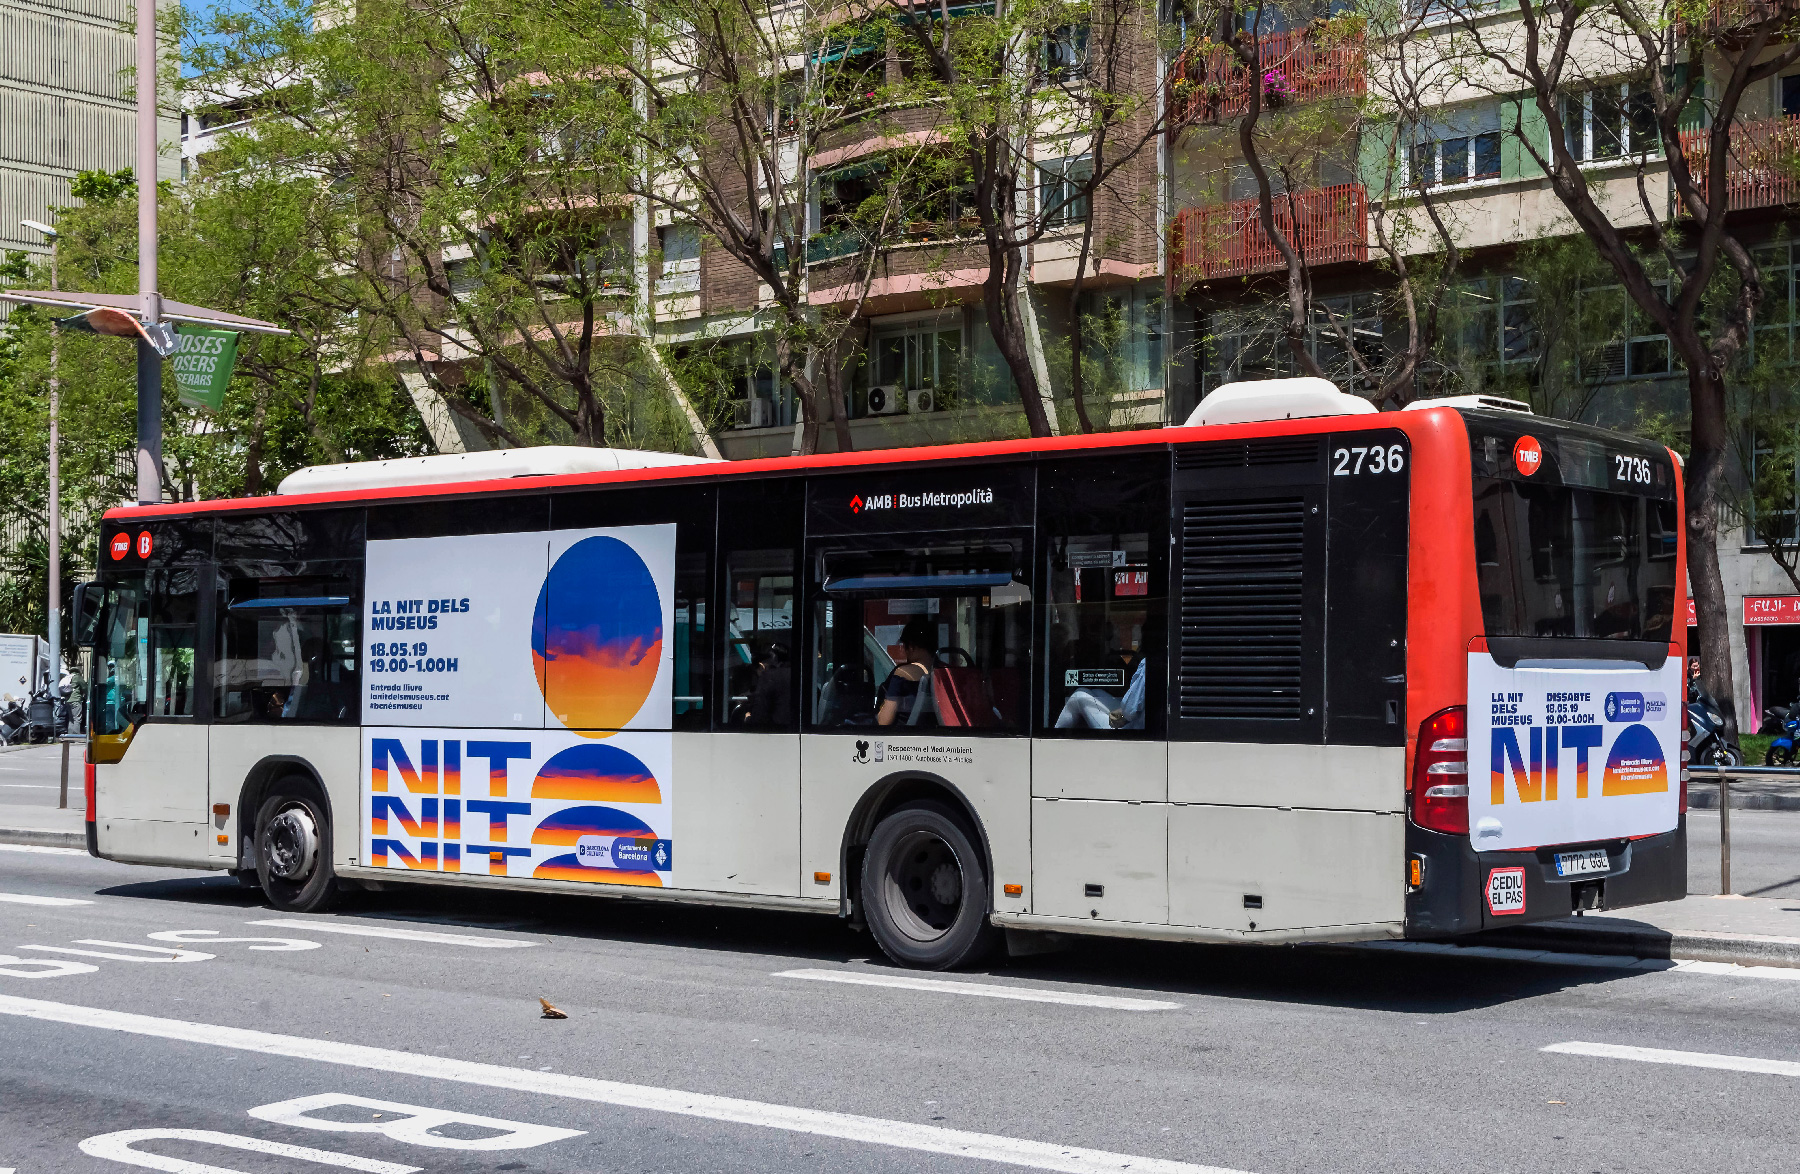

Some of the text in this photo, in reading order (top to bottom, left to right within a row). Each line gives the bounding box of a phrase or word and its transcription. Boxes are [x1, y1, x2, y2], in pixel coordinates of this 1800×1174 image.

[1333, 444, 1404, 476] 2736
[1519, 450, 1539, 463] TMB
[1615, 454, 1651, 484] 2736
[865, 487, 993, 510] AMB Bus Metropolità
[114, 542, 128, 551] TMB
[140, 536, 150, 554] B
[372, 598, 470, 614] LA NIT DELS
[371, 615, 438, 631] MUSEUS
[370, 642, 428, 657] 18.05.19
[370, 683, 423, 692] Entrada lliure
[370, 692, 450, 701] lanitdelsmuseus.cat
[1491, 692, 1524, 703] LA NIT
[1546, 692, 1591, 702] DISSABTE
[1491, 703, 1518, 714] DELS
[1545, 703, 1579, 713] 18.05.19
[1491, 714, 1533, 726] MUSEUS
[946, 746, 973, 754] Ambient
[372, 738, 531, 797] NIT
[1491, 725, 1603, 805] NIT
[372, 796, 531, 842] NIT
[372, 838, 531, 876] NIT
[618, 851, 648, 861] Barcelona
[1492, 874, 1523, 891] CEDIU
[1492, 890, 1523, 905] EL PAS
